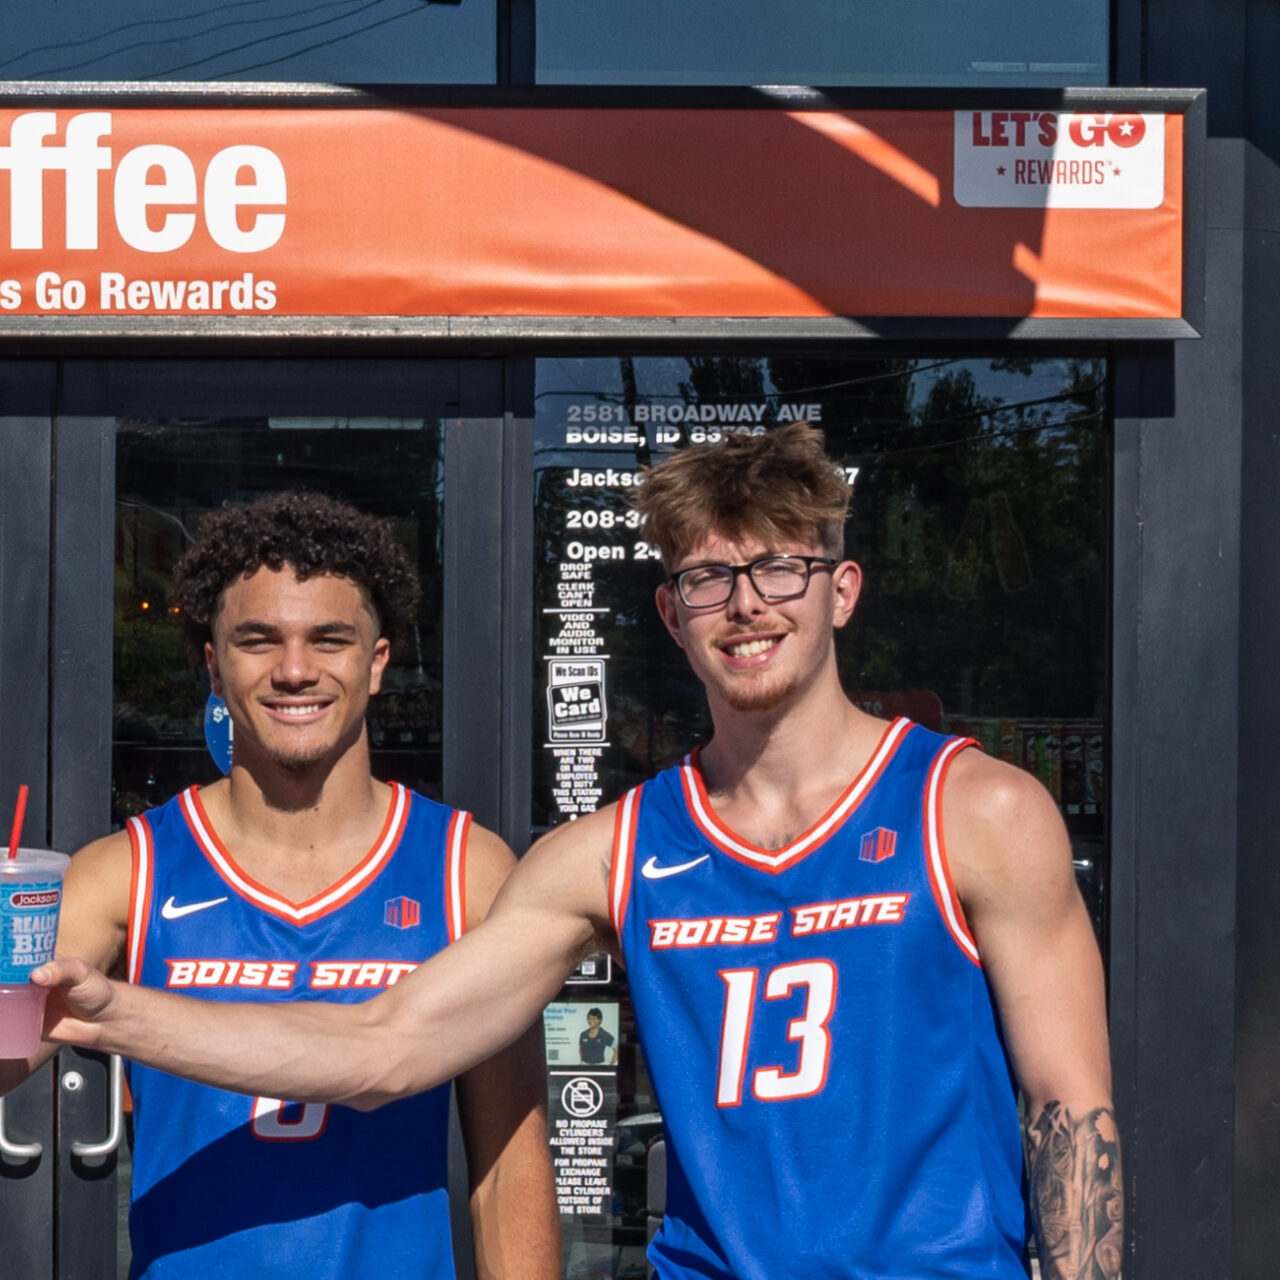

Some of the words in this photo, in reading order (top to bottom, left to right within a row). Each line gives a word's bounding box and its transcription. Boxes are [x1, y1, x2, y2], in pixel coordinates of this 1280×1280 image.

[972, 111, 1058, 147] LET'S
[1068, 111, 1147, 148] GO
[35, 271, 86, 310] Go
[100, 272, 278, 310] Rewards
[567, 405, 624, 422] 2581
[634, 404, 767, 422] BROADWAY
[776, 404, 822, 422] AVE
[566, 426, 646, 446] BOISE,
[656, 426, 680, 443] ID
[567, 541, 625, 562] Open
[560, 563, 592, 571] DROP
[561, 571, 591, 579] SAFE
[557, 582, 595, 591] CLERK
[558, 591, 593, 599] CAN'T
[561, 599, 592, 607] OPEN
[559, 613, 594, 622] VIDEO
[549, 637, 604, 646] MONITOR
[556, 646, 569, 654] IN
[573, 646, 597, 654] USE
[568, 666, 586, 676] Scan
[560, 686, 592, 703] We
[554, 698, 601, 718] Card
[578, 748, 602, 756] THERE
[556, 772, 598, 780] EMPLOYEES
[572, 788, 602, 796] STATION
[580, 804, 596, 812] GAS
[11, 914, 57, 933] REALLY
[648, 912, 782, 951] BOISE
[790, 894, 910, 937] STATE
[12, 932, 55, 953] BIG
[165, 959, 299, 990] BOISE
[310, 960, 419, 990] STAT
[716, 957, 838, 1109] 13
[556, 1120, 568, 1128] NO
[570, 1120, 608, 1128] PROPANE
[559, 1129, 604, 1137] CYLINDERS
[588, 1137, 613, 1145] INSIDE
[560, 1147, 575, 1155] THE
[578, 1147, 602, 1155] STORE
[554, 1158, 569, 1167] FOR
[572, 1158, 608, 1167] PROPANE
[560, 1168, 601, 1176] EXCHANGE
[584, 1177, 607, 1186] LEAVE
[573, 1187, 611, 1195] CYLINDER
[557, 1196, 590, 1204] OUTSIDE
[592, 1196, 602, 1204] OF
[560, 1205, 574, 1214] THE
[577, 1205, 601, 1214] STORE
